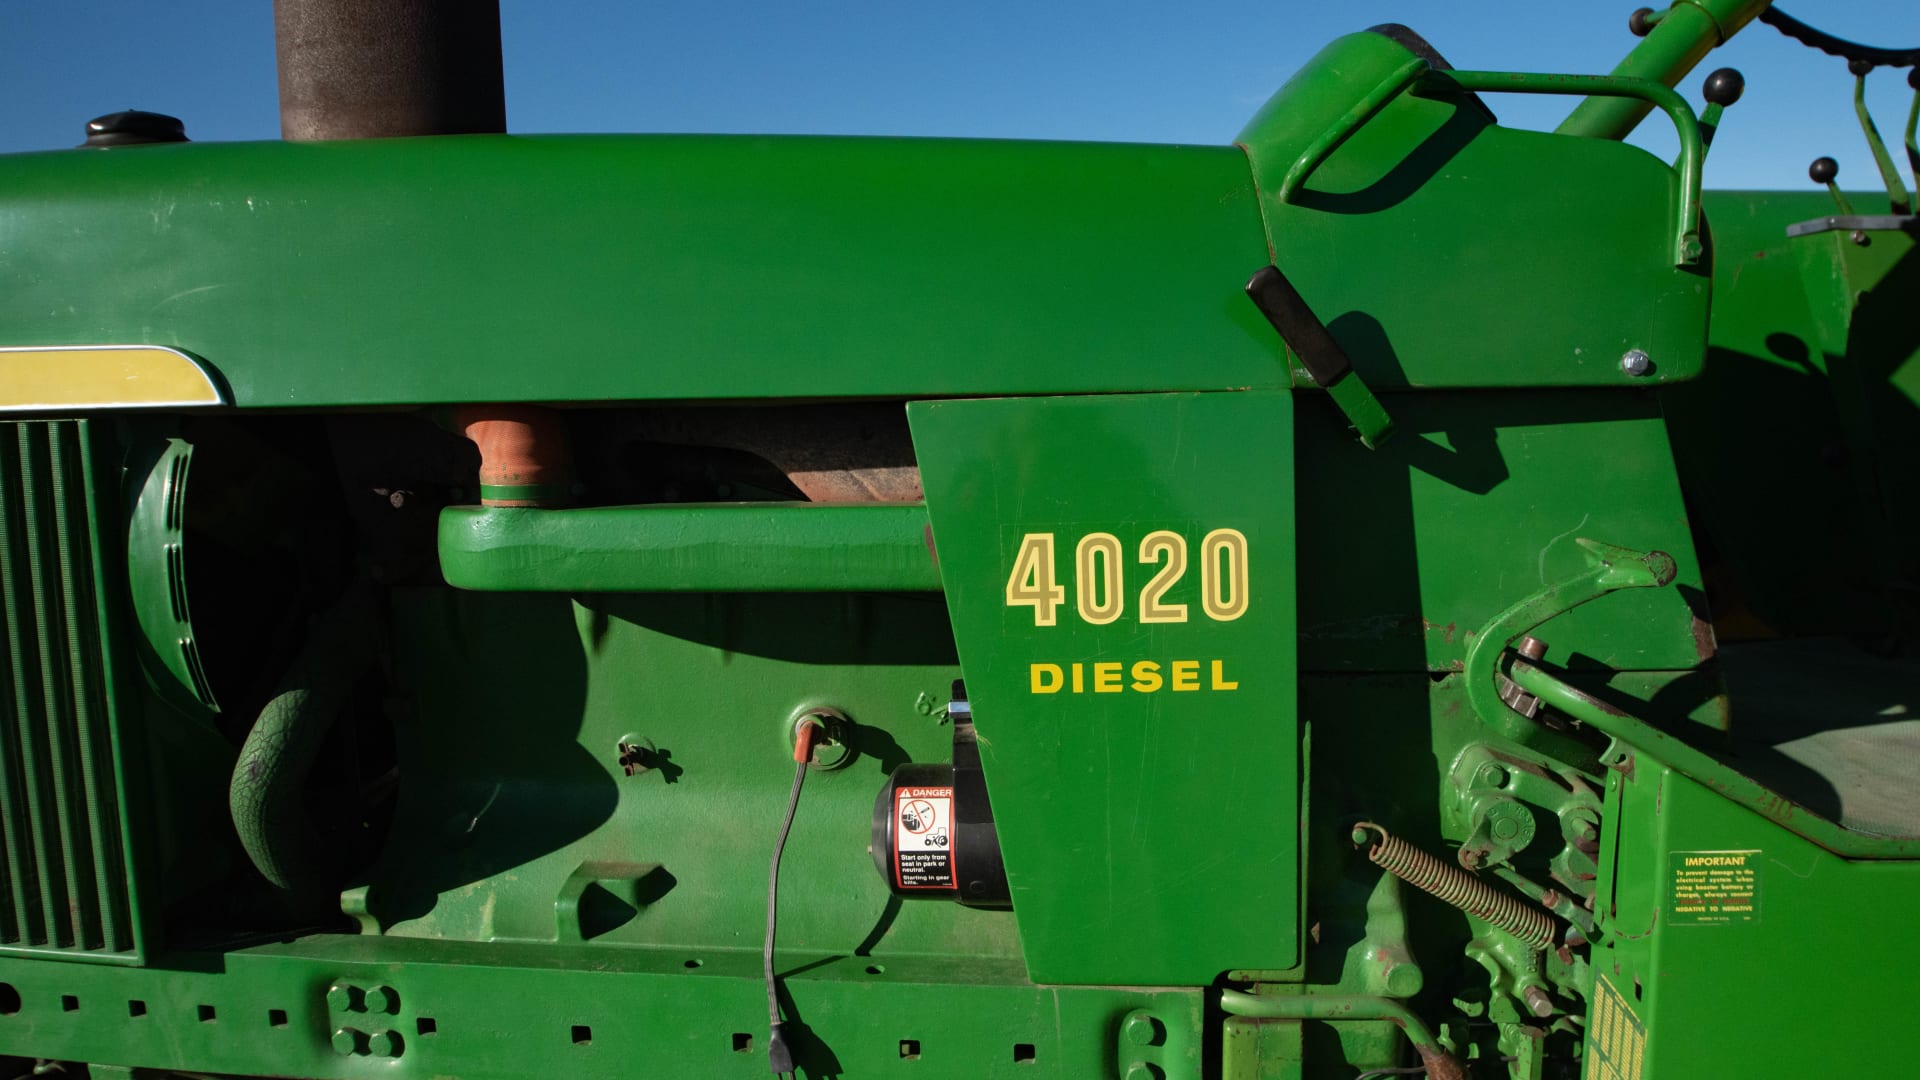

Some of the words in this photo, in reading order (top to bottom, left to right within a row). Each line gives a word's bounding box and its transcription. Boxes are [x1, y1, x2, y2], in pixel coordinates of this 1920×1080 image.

[1006, 528, 1249, 627] 4020
[1030, 659, 1239, 694] DIESEL
[912, 789, 952, 797] DANGER
[916, 854, 930, 862] only
[1685, 856, 1746, 867] IMPORTANT
